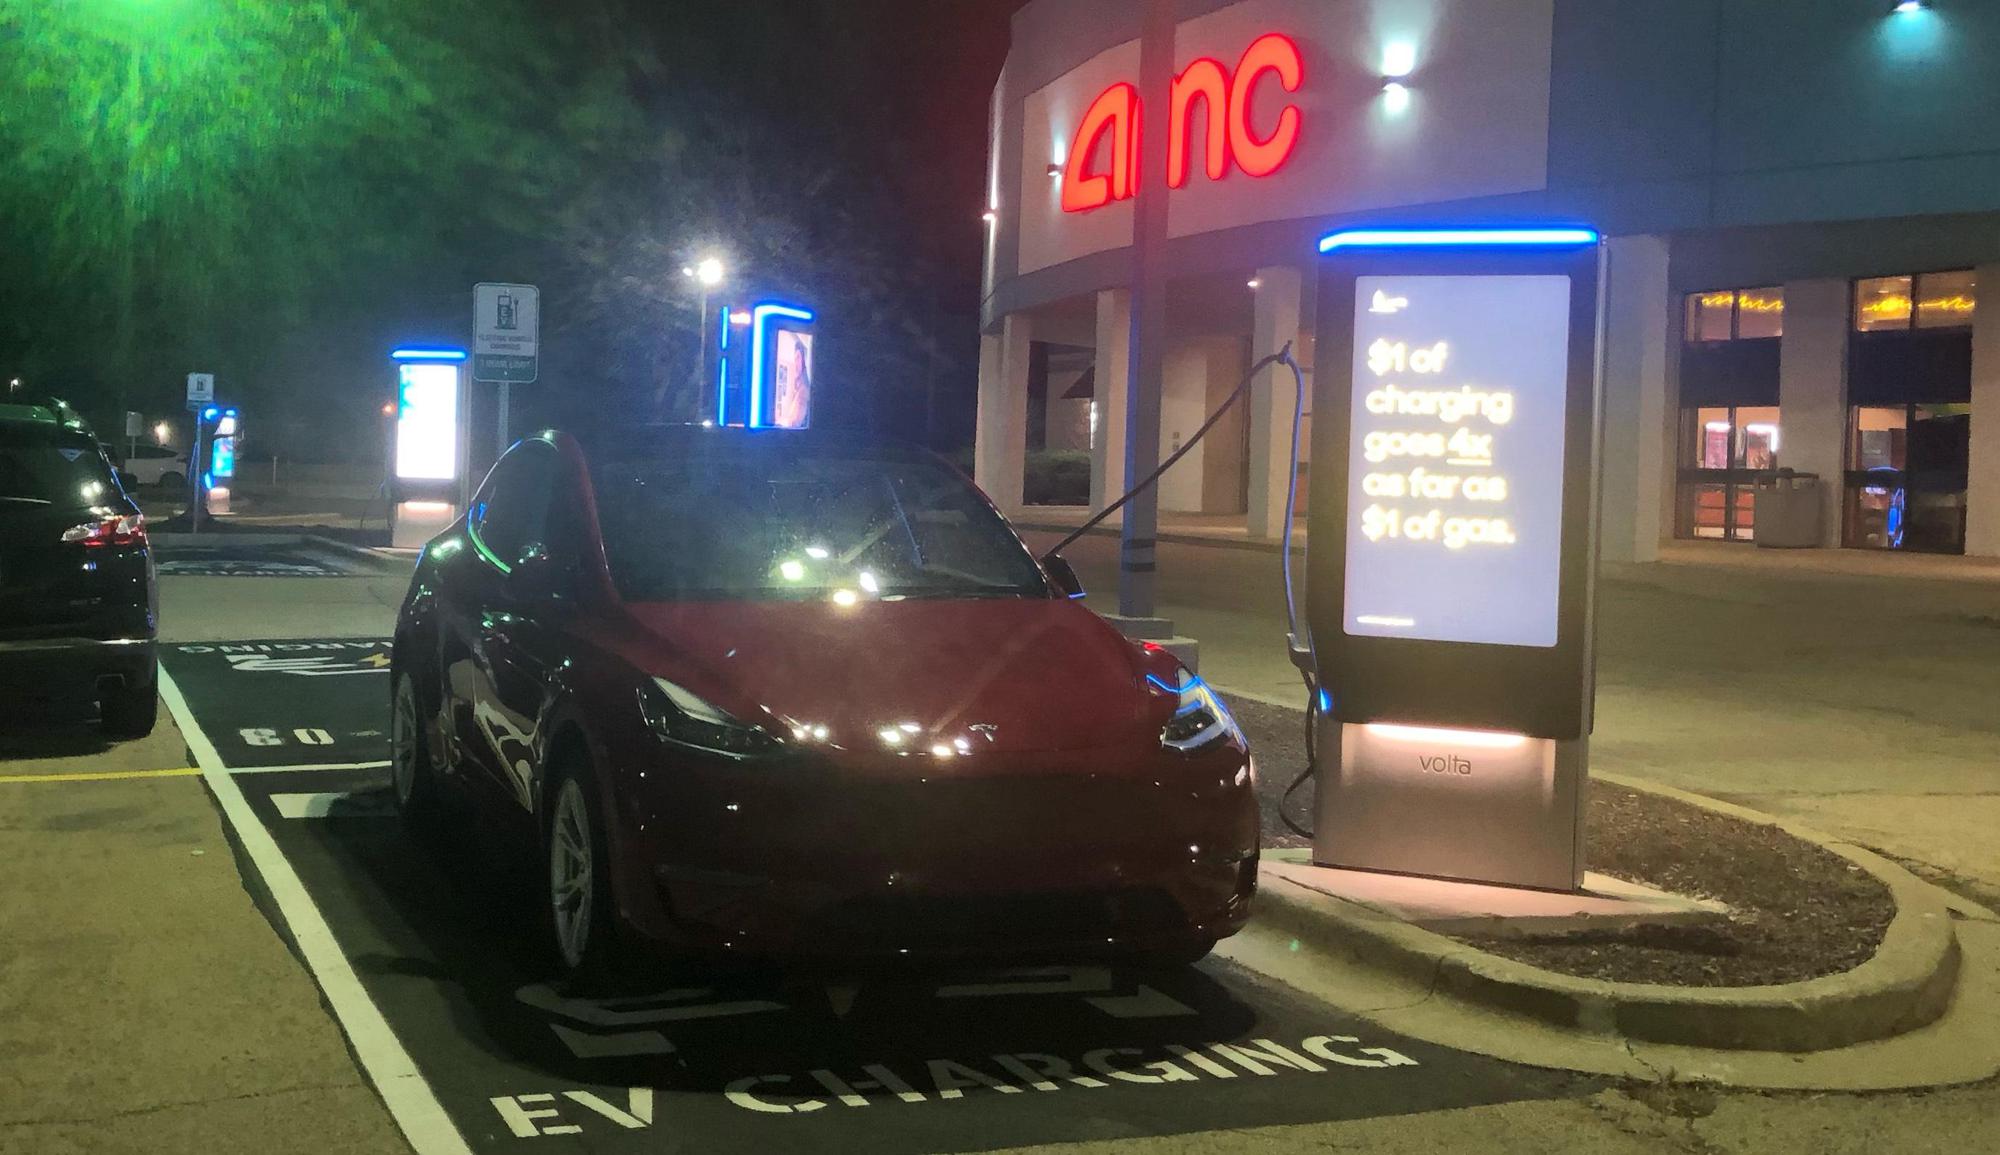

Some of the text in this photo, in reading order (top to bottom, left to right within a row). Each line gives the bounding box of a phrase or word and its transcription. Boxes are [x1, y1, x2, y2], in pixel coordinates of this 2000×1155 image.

[1367, 338, 1448, 375] $1 of
[1365, 384, 1513, 424] charging
[1364, 427, 1492, 462] goes 4x
[1362, 466, 1507, 500] as far as
[1361, 503, 1399, 542] $1
[1403, 509, 1440, 539] of
[1419, 754, 1472, 775] volta
[490, 1035, 1419, 1138] EV CHARGING
